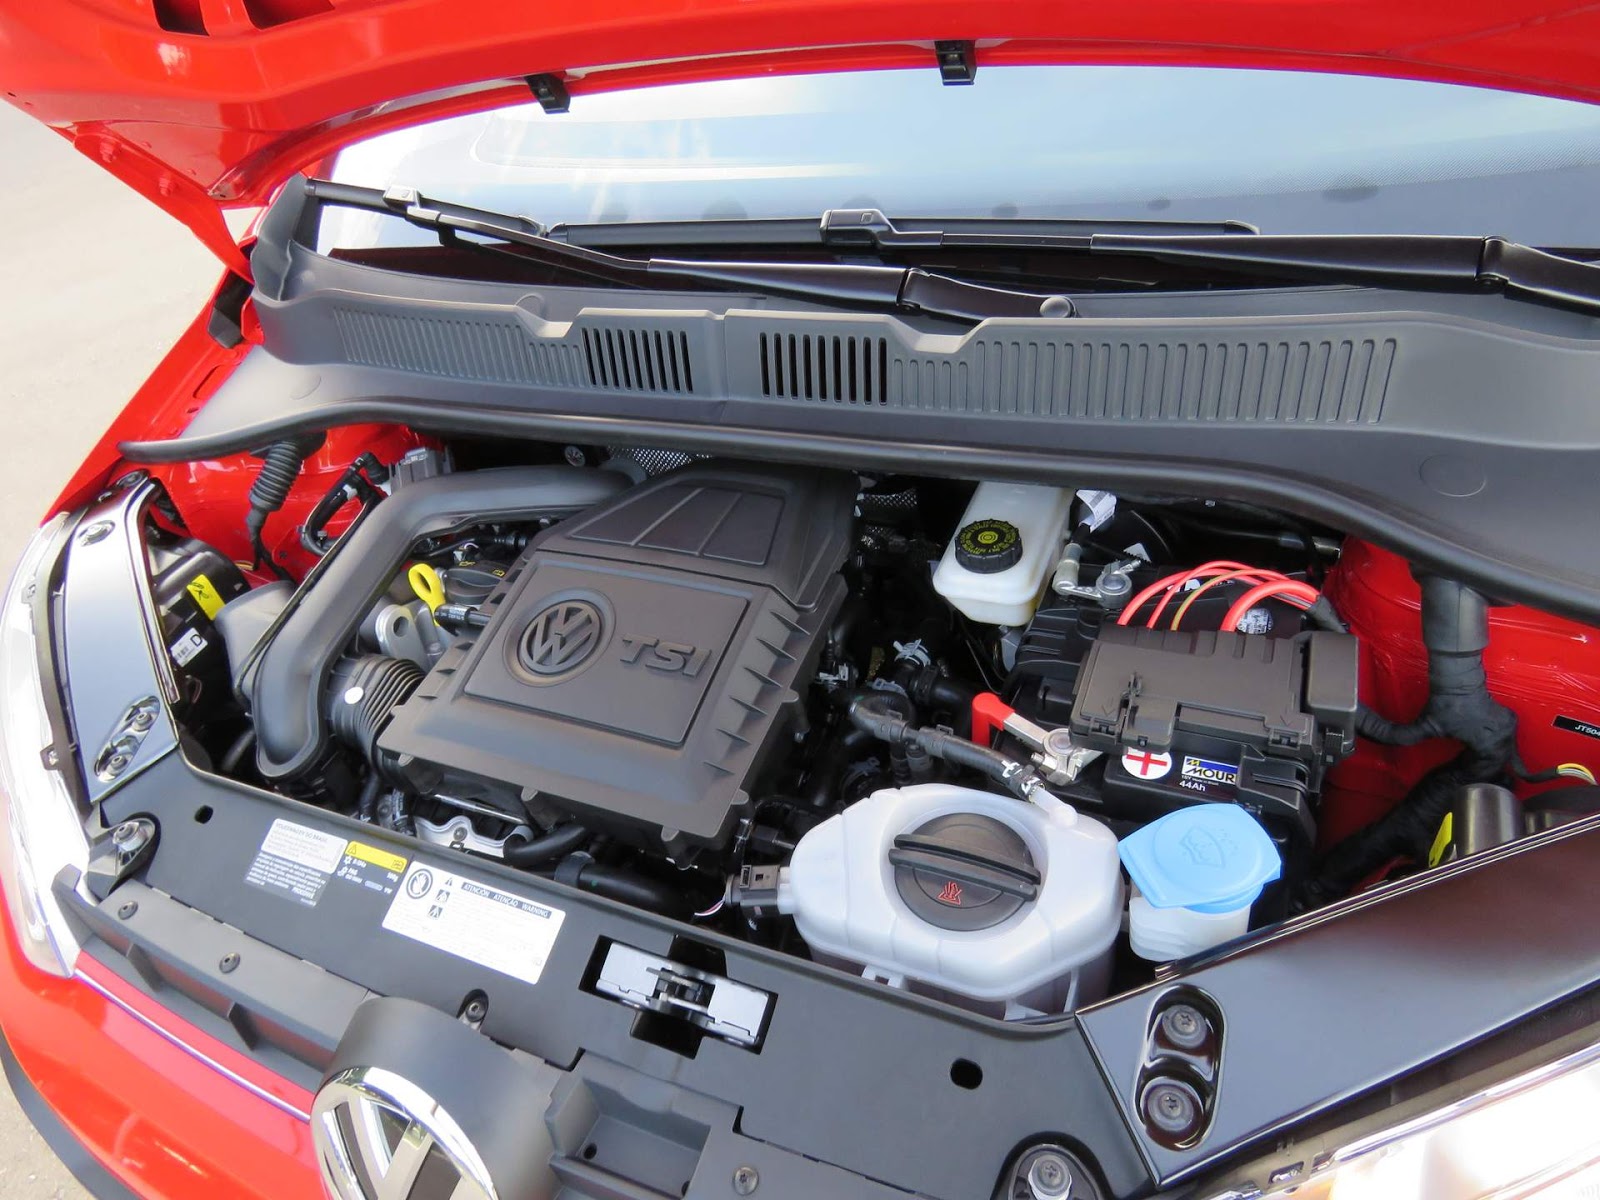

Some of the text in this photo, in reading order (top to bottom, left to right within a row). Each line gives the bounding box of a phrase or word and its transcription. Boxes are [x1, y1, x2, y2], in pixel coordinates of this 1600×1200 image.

[619, 632, 713, 678] TSI
[1179, 780, 1206, 792] 44Ah
[521, 902, 549, 918] WARNING
